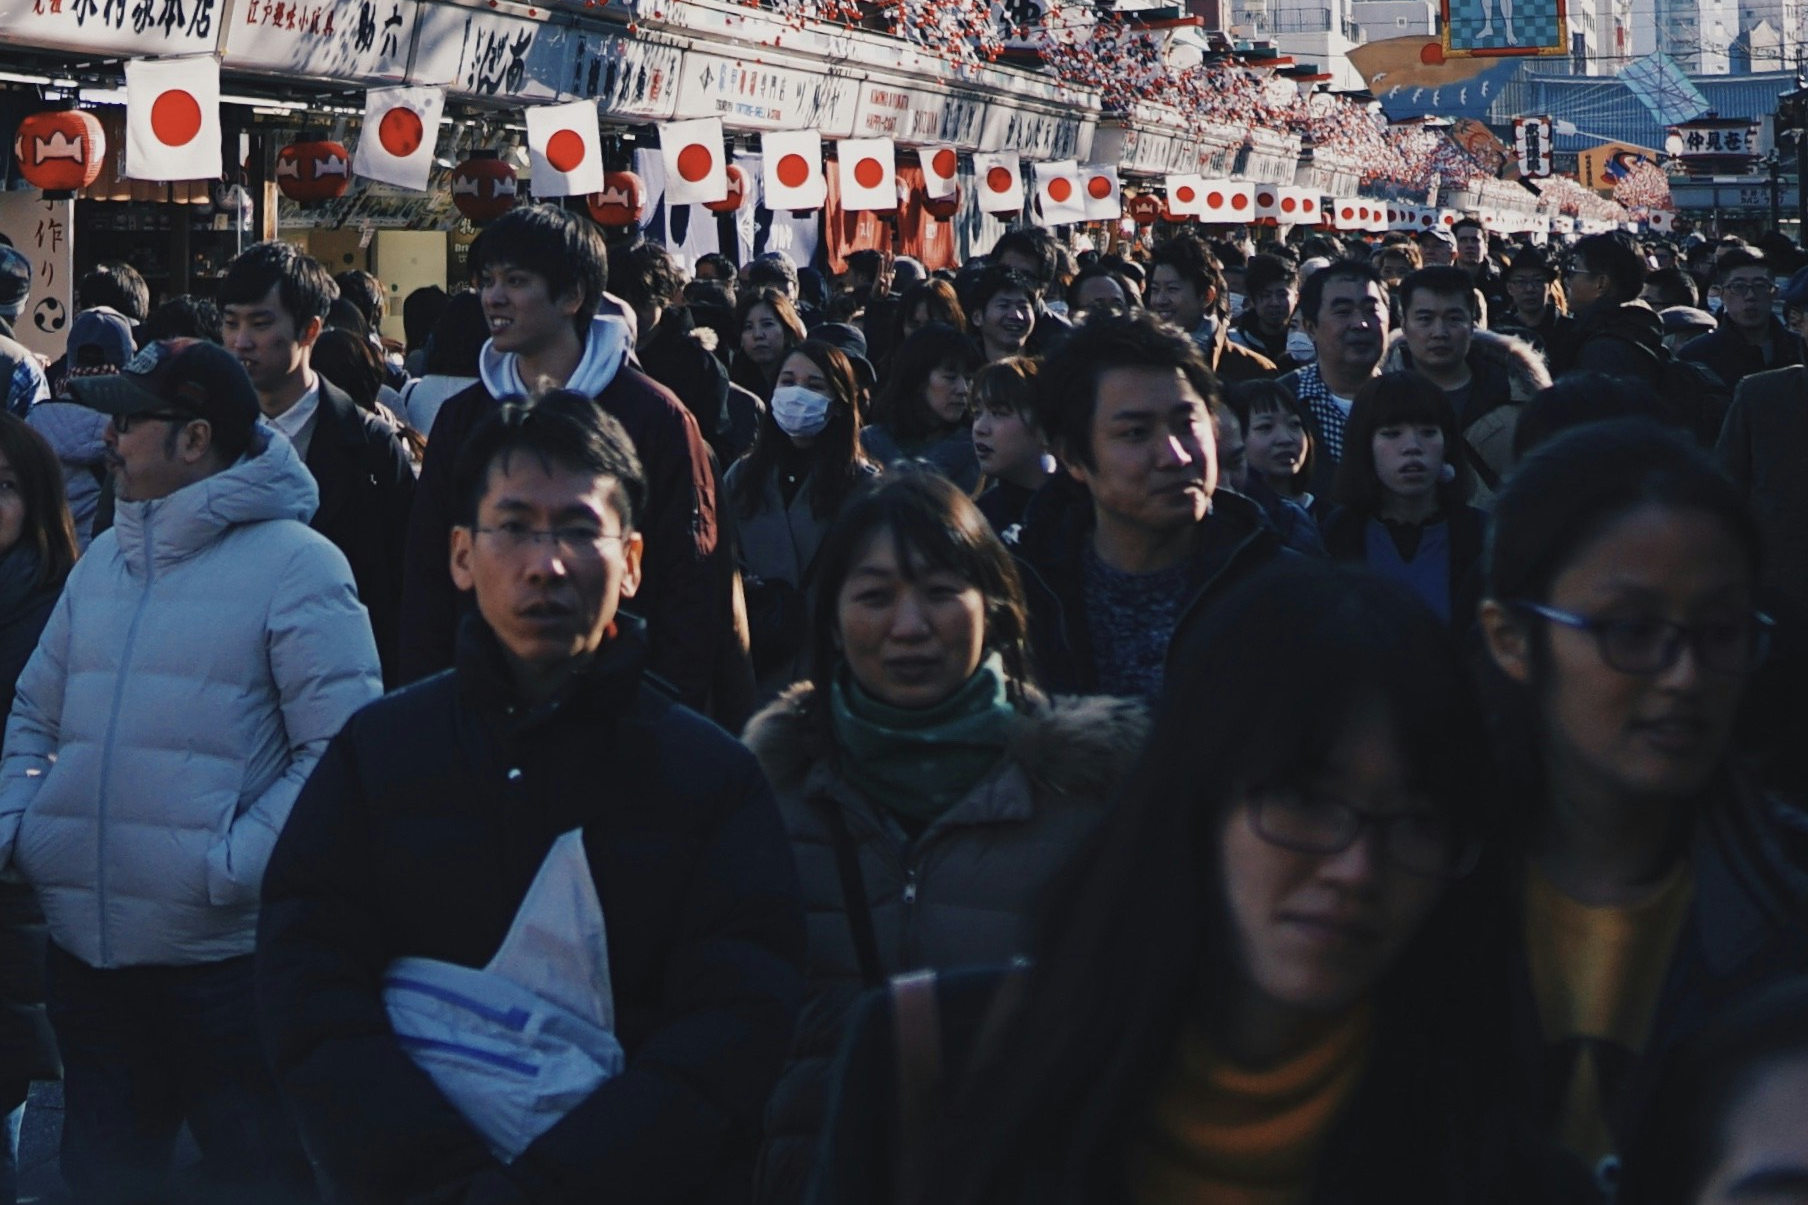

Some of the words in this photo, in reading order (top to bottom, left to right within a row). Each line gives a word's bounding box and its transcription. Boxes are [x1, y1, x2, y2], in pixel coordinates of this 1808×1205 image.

[354, 0, 404, 58] 助六
[1686, 130, 1743, 152] 仲見世
